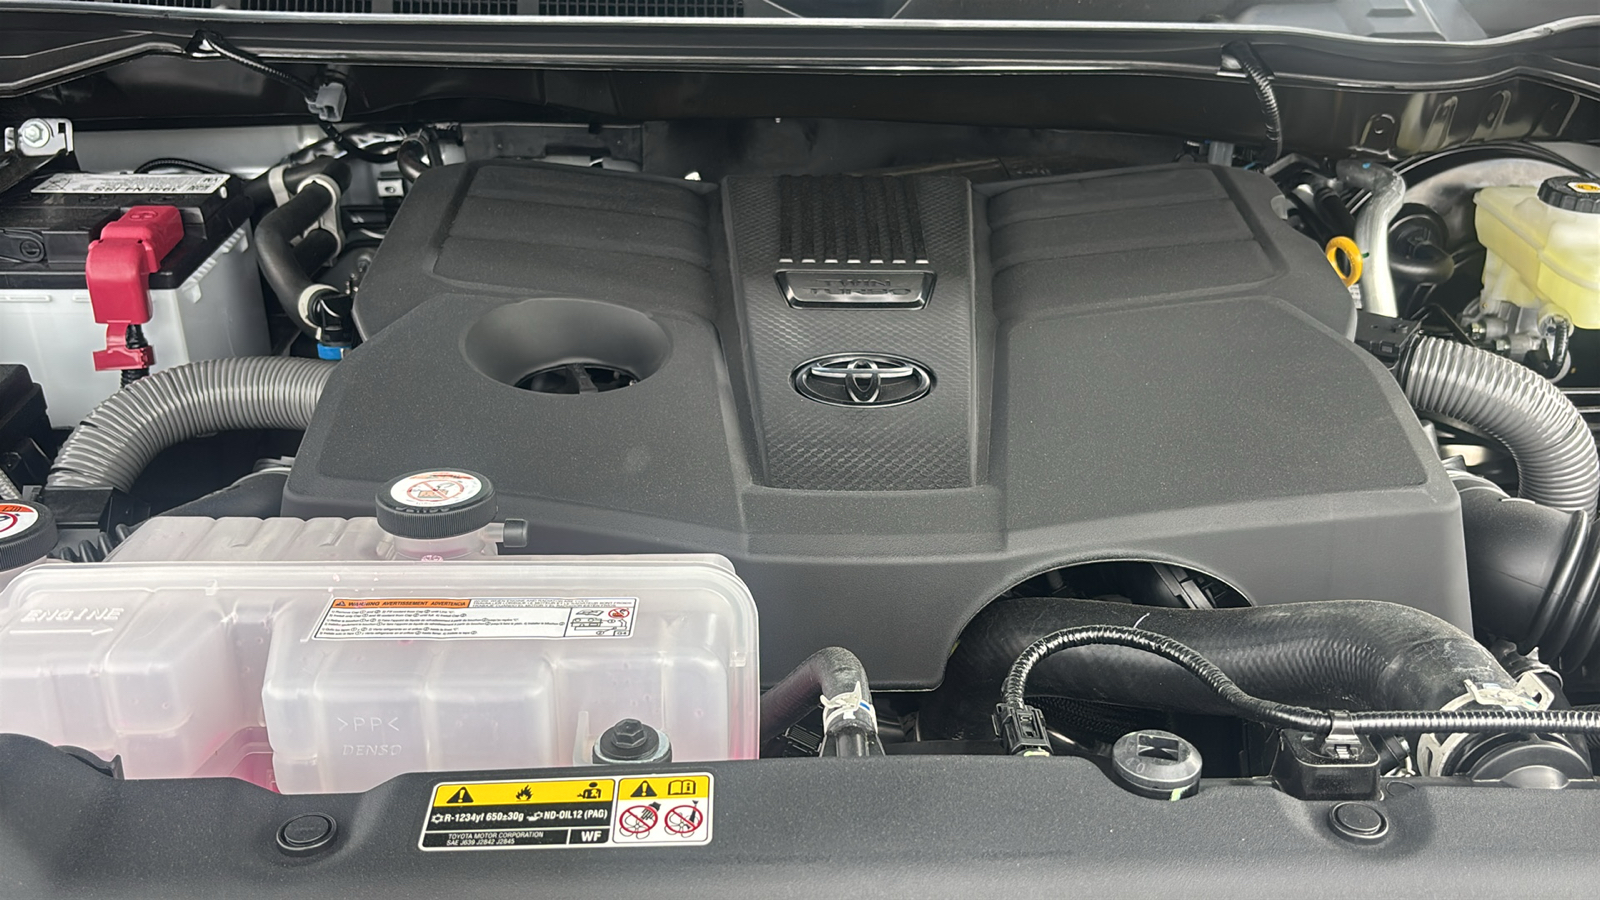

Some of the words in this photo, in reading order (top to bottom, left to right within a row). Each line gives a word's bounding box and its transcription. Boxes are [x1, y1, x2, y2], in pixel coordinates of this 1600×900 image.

[20, 607, 124, 622] ENGINE
[342, 744, 402, 756] DENSO
[486, 812, 525, 822] 650±30g
[543, 810, 583, 820] ND-OIL12
[584, 809, 608, 820] (PAG)
[499, 831, 544, 839] CORPORATION
[581, 830, 602, 842] WF
